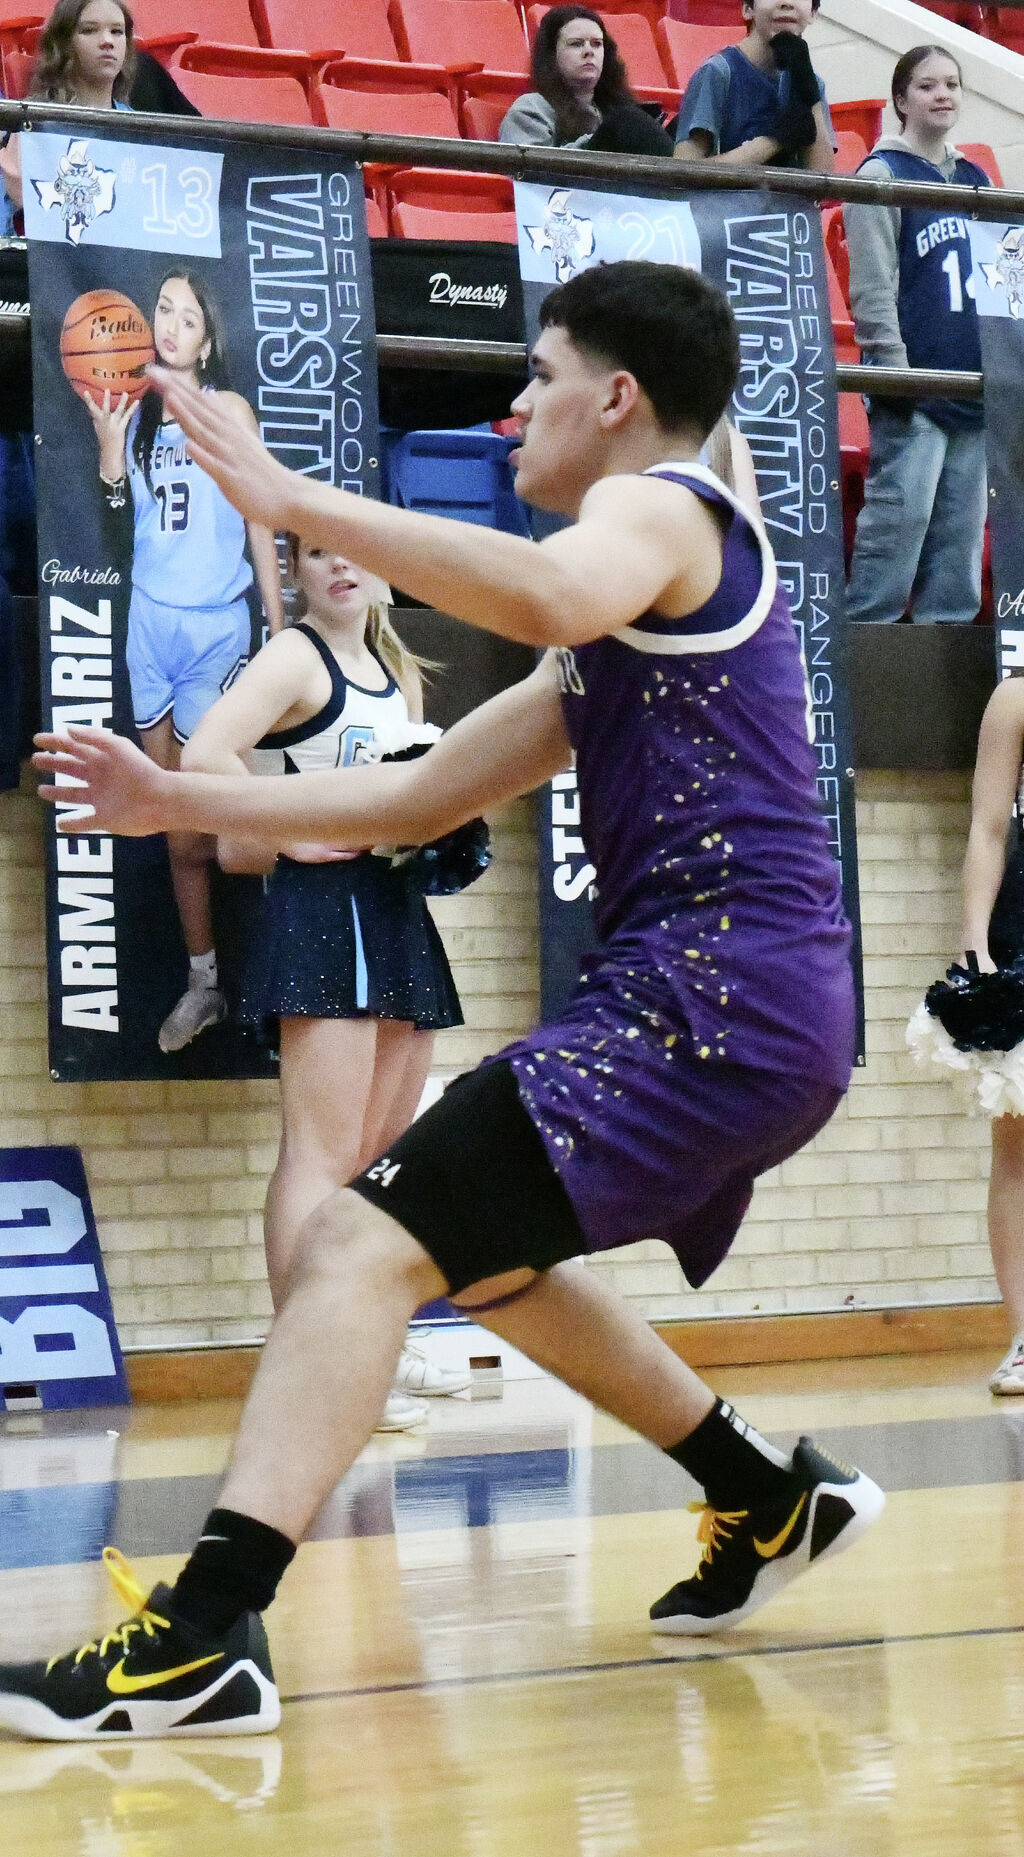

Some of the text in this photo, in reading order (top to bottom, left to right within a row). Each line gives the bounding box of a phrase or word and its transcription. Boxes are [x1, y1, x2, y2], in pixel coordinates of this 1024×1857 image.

[428, 272, 508, 310] Dynasty
[724, 213, 804, 538] VARSITY
[792, 212, 827, 534] GREENWOOD
[153, 480, 191, 533] 13
[41, 558, 123, 587] Gabriela
[366, 1158, 402, 1188] 24
